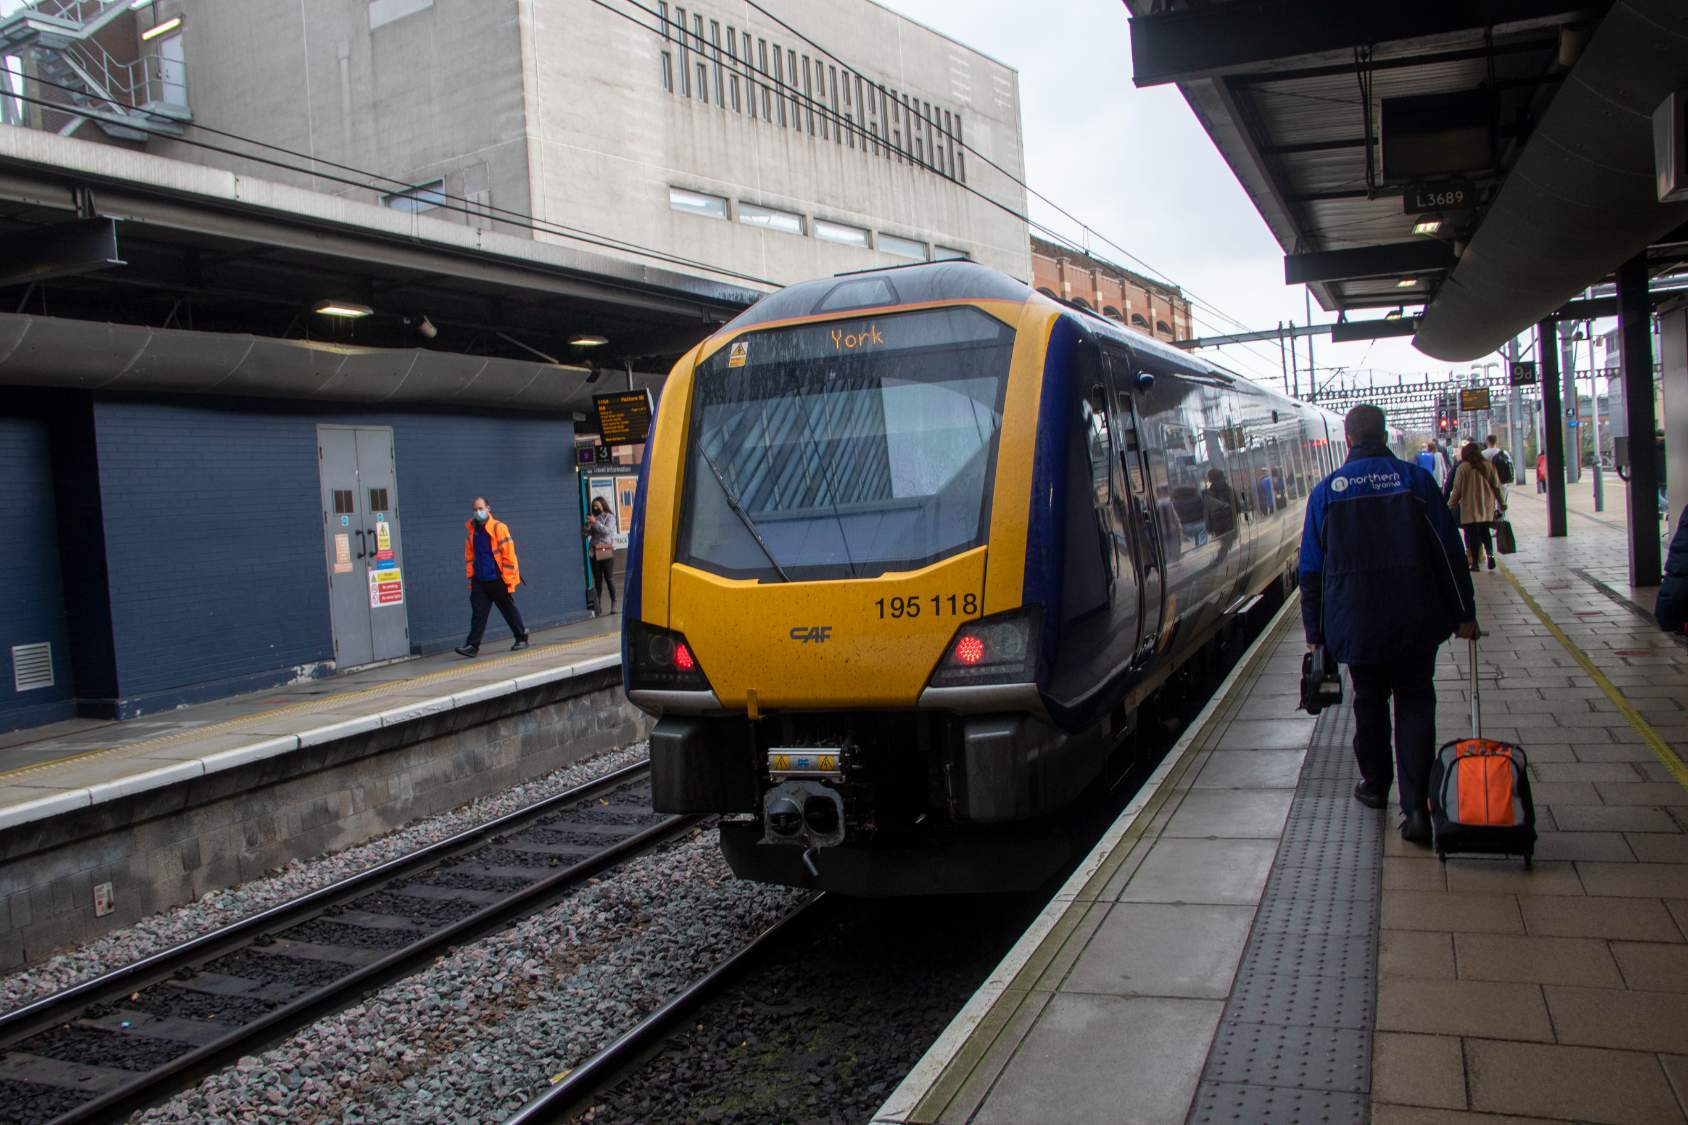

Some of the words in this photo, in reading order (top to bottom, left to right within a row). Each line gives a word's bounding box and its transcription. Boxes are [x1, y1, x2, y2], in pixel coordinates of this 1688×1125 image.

[1416, 190, 1464, 208] L3689
[831, 324, 885, 351] York
[1513, 365, 1533, 380] 9d
[600, 446, 608, 458] 3
[1349, 472, 1400, 486] northern
[874, 596, 921, 619] 195
[930, 593, 978, 617] 118
[789, 625, 833, 645] CAF
